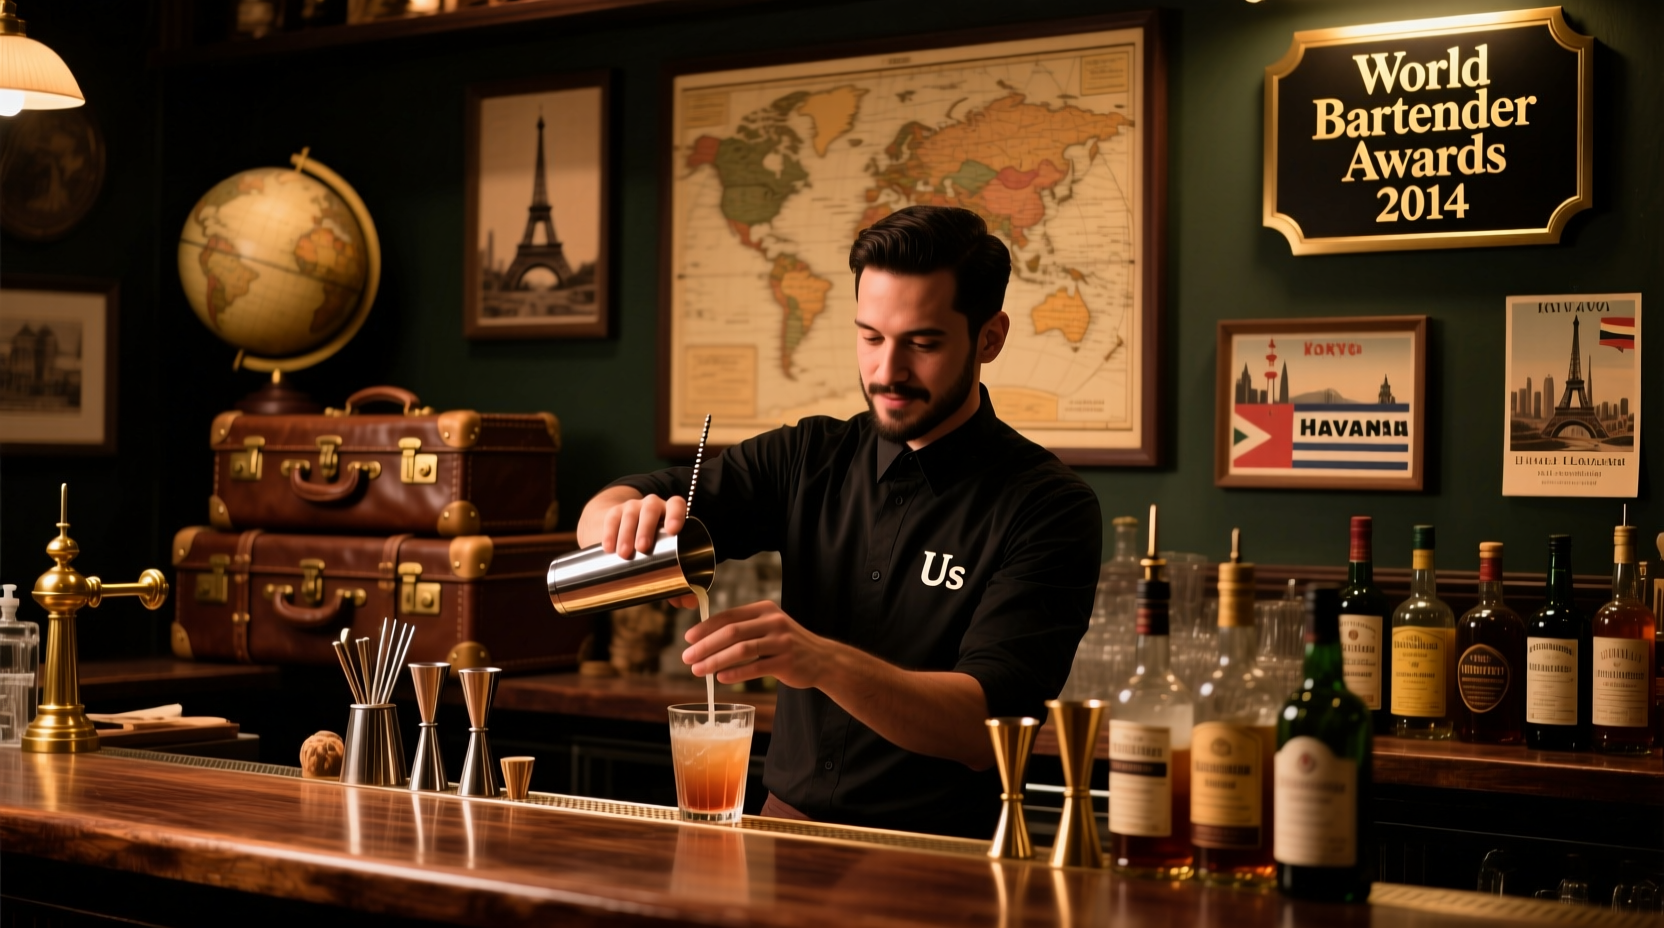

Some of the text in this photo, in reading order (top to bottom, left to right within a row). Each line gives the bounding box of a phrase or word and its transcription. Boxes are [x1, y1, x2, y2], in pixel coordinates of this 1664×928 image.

[1353, 44, 1490, 95] World
[1312, 88, 1537, 140] Bartender
[1341, 134, 1507, 182] Awards
[1376, 183, 1469, 223] 2014
[921, 550, 965, 590] Us
